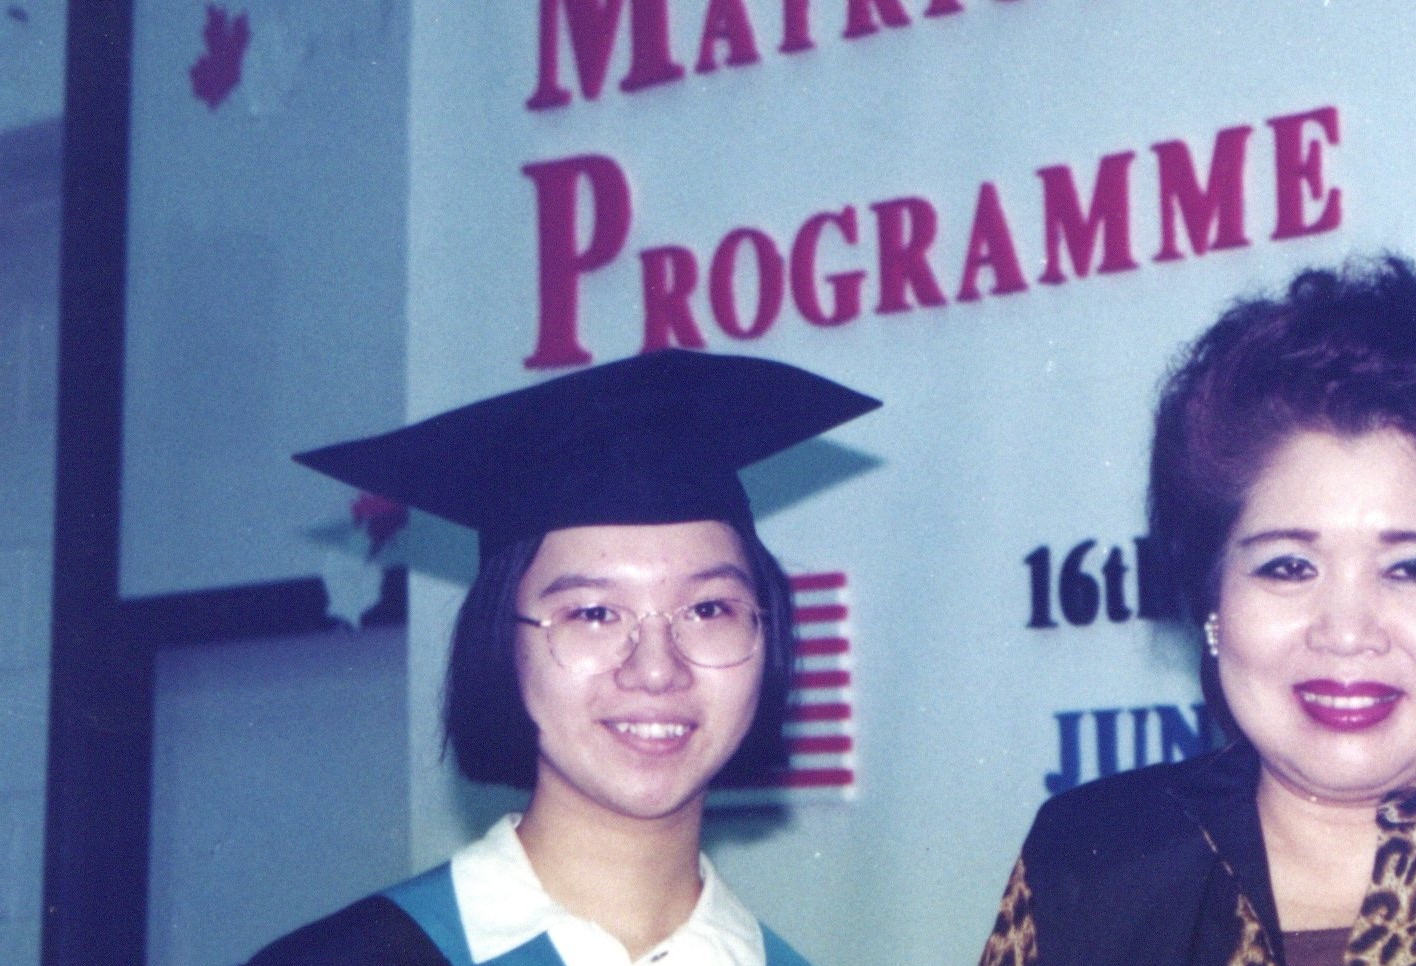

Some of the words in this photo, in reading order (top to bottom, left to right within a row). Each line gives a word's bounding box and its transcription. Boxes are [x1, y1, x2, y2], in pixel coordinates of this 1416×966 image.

[521, 105, 1343, 371] PROGRAMME
[1024, 537, 1160, 630] 16t
[1044, 703, 1214, 794] JUN
